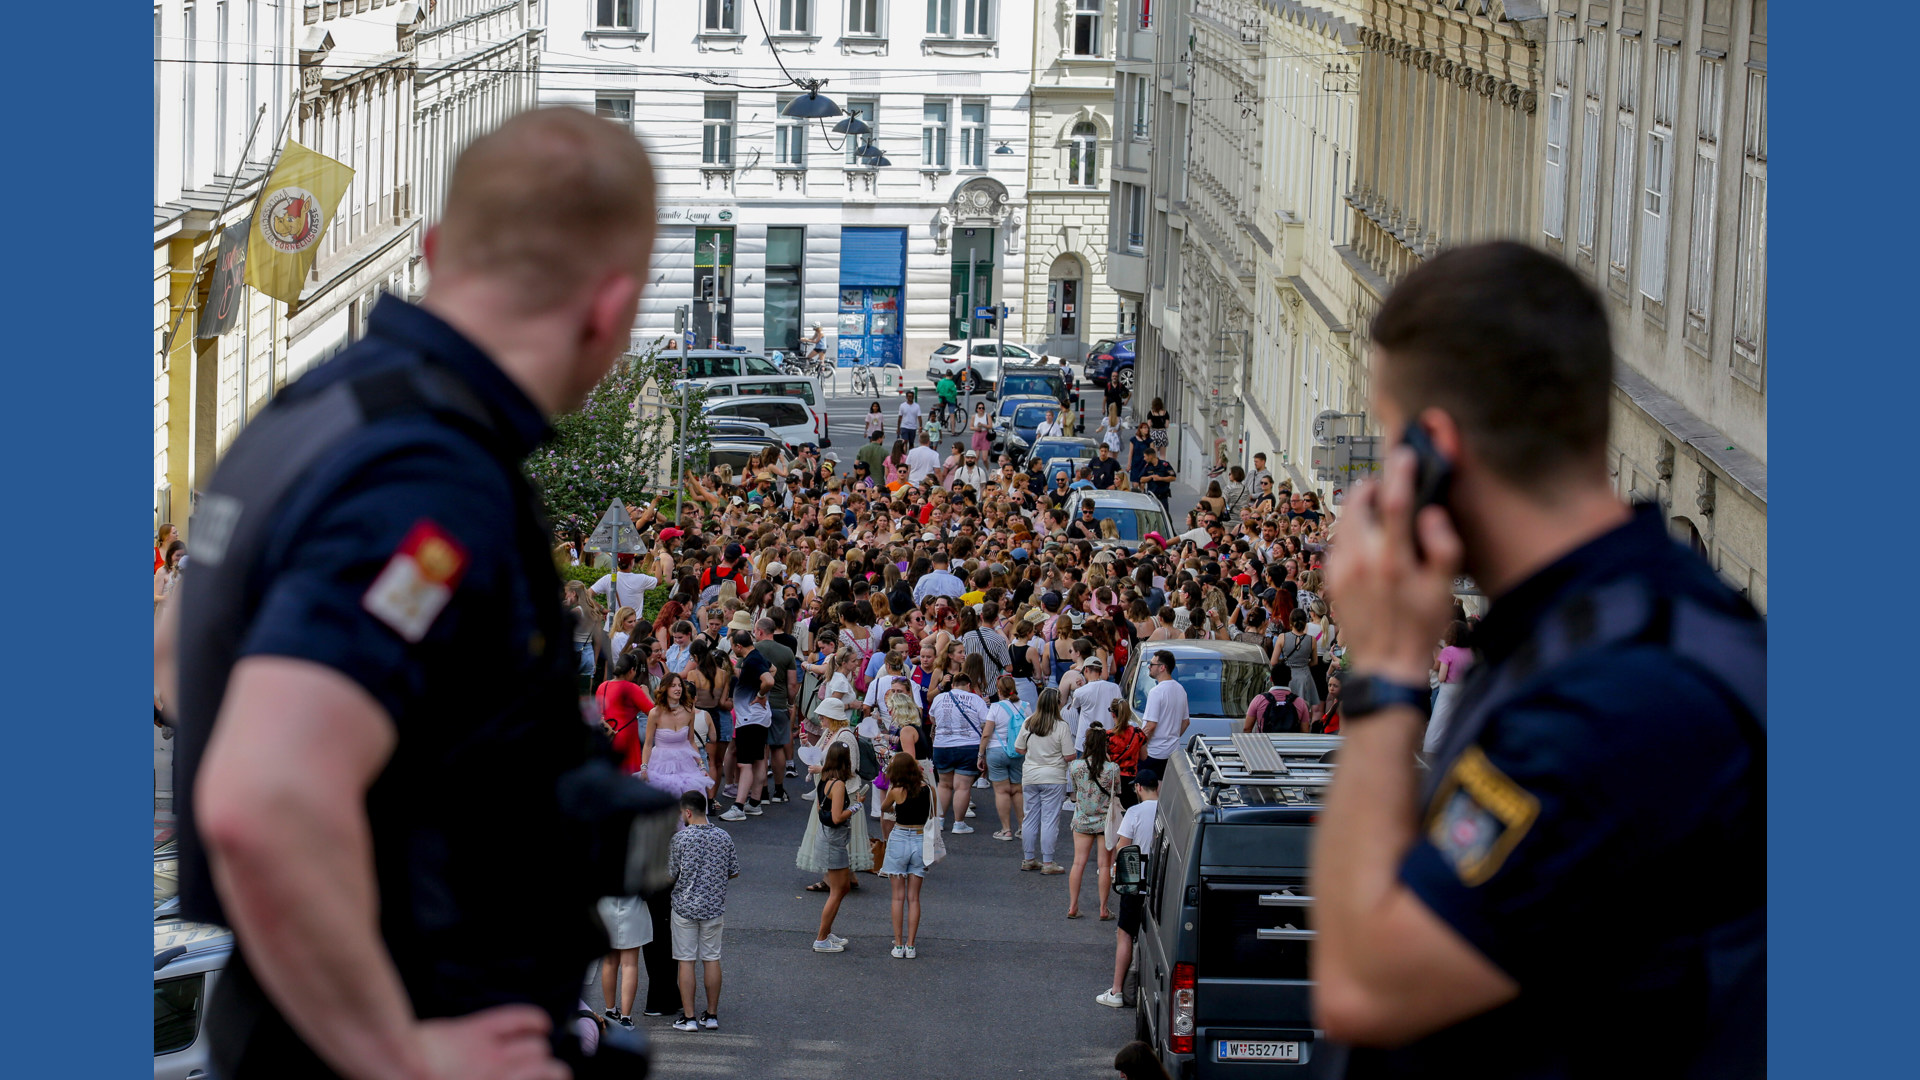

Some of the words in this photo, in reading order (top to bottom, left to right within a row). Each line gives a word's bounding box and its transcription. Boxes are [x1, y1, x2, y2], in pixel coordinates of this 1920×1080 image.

[262, 193, 284, 243] VOLKSSCHULE
[685, 208, 711, 223] Lounge
[1230, 1043, 1239, 1056] W
[1248, 1044, 1294, 1056] 55271F
